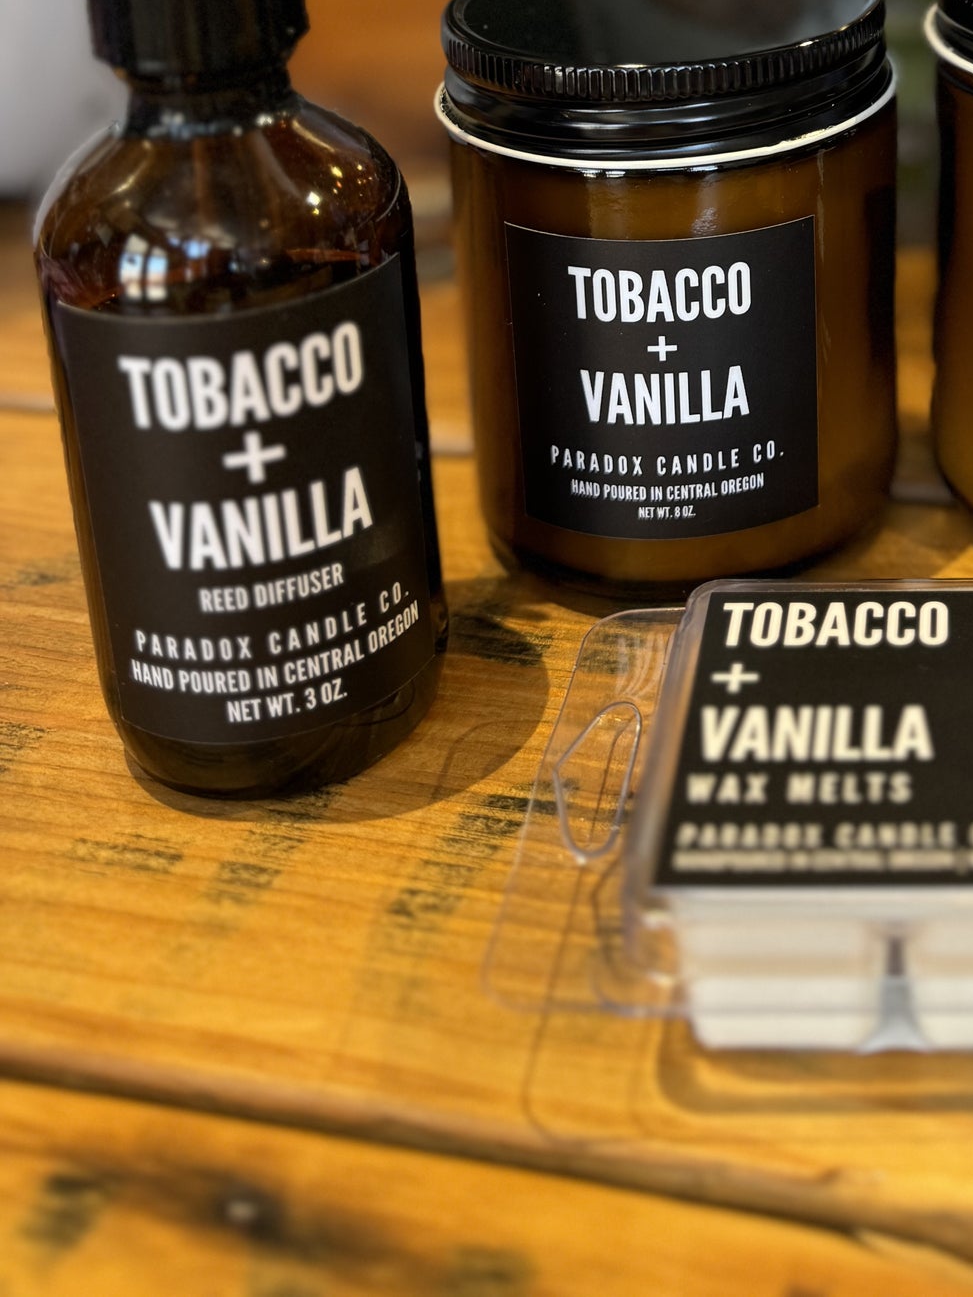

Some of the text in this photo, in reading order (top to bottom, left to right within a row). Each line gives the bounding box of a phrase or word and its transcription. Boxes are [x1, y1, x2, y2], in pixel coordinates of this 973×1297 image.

[568, 261, 751, 323] TOBACCO
[647, 335, 677, 362] +
[119, 322, 365, 430] TOBACCO
[580, 365, 750, 425] VANILLA
[222, 431, 286, 483] +
[551, 440, 784, 476] PARADOX CANDLE CO.
[571, 472, 765, 501] HAND POURED IN CENTRAL OREGON
[150, 466, 373, 569] VANILLA
[638, 506, 655, 520] NET
[200, 563, 344, 613] REED DIFFUSER
[136, 582, 410, 662] PARADOX CANDLE CO.
[722, 601, 950, 648] TOBACCO
[131, 601, 419, 694] HAND POURED IN CENTRAL OREGON
[228, 679, 347, 724] NET WT. 3 OZ.
[711, 662, 760, 694] +
[701, 705, 934, 762] VANILLA
[687, 772, 912, 803] WAX MELTS
